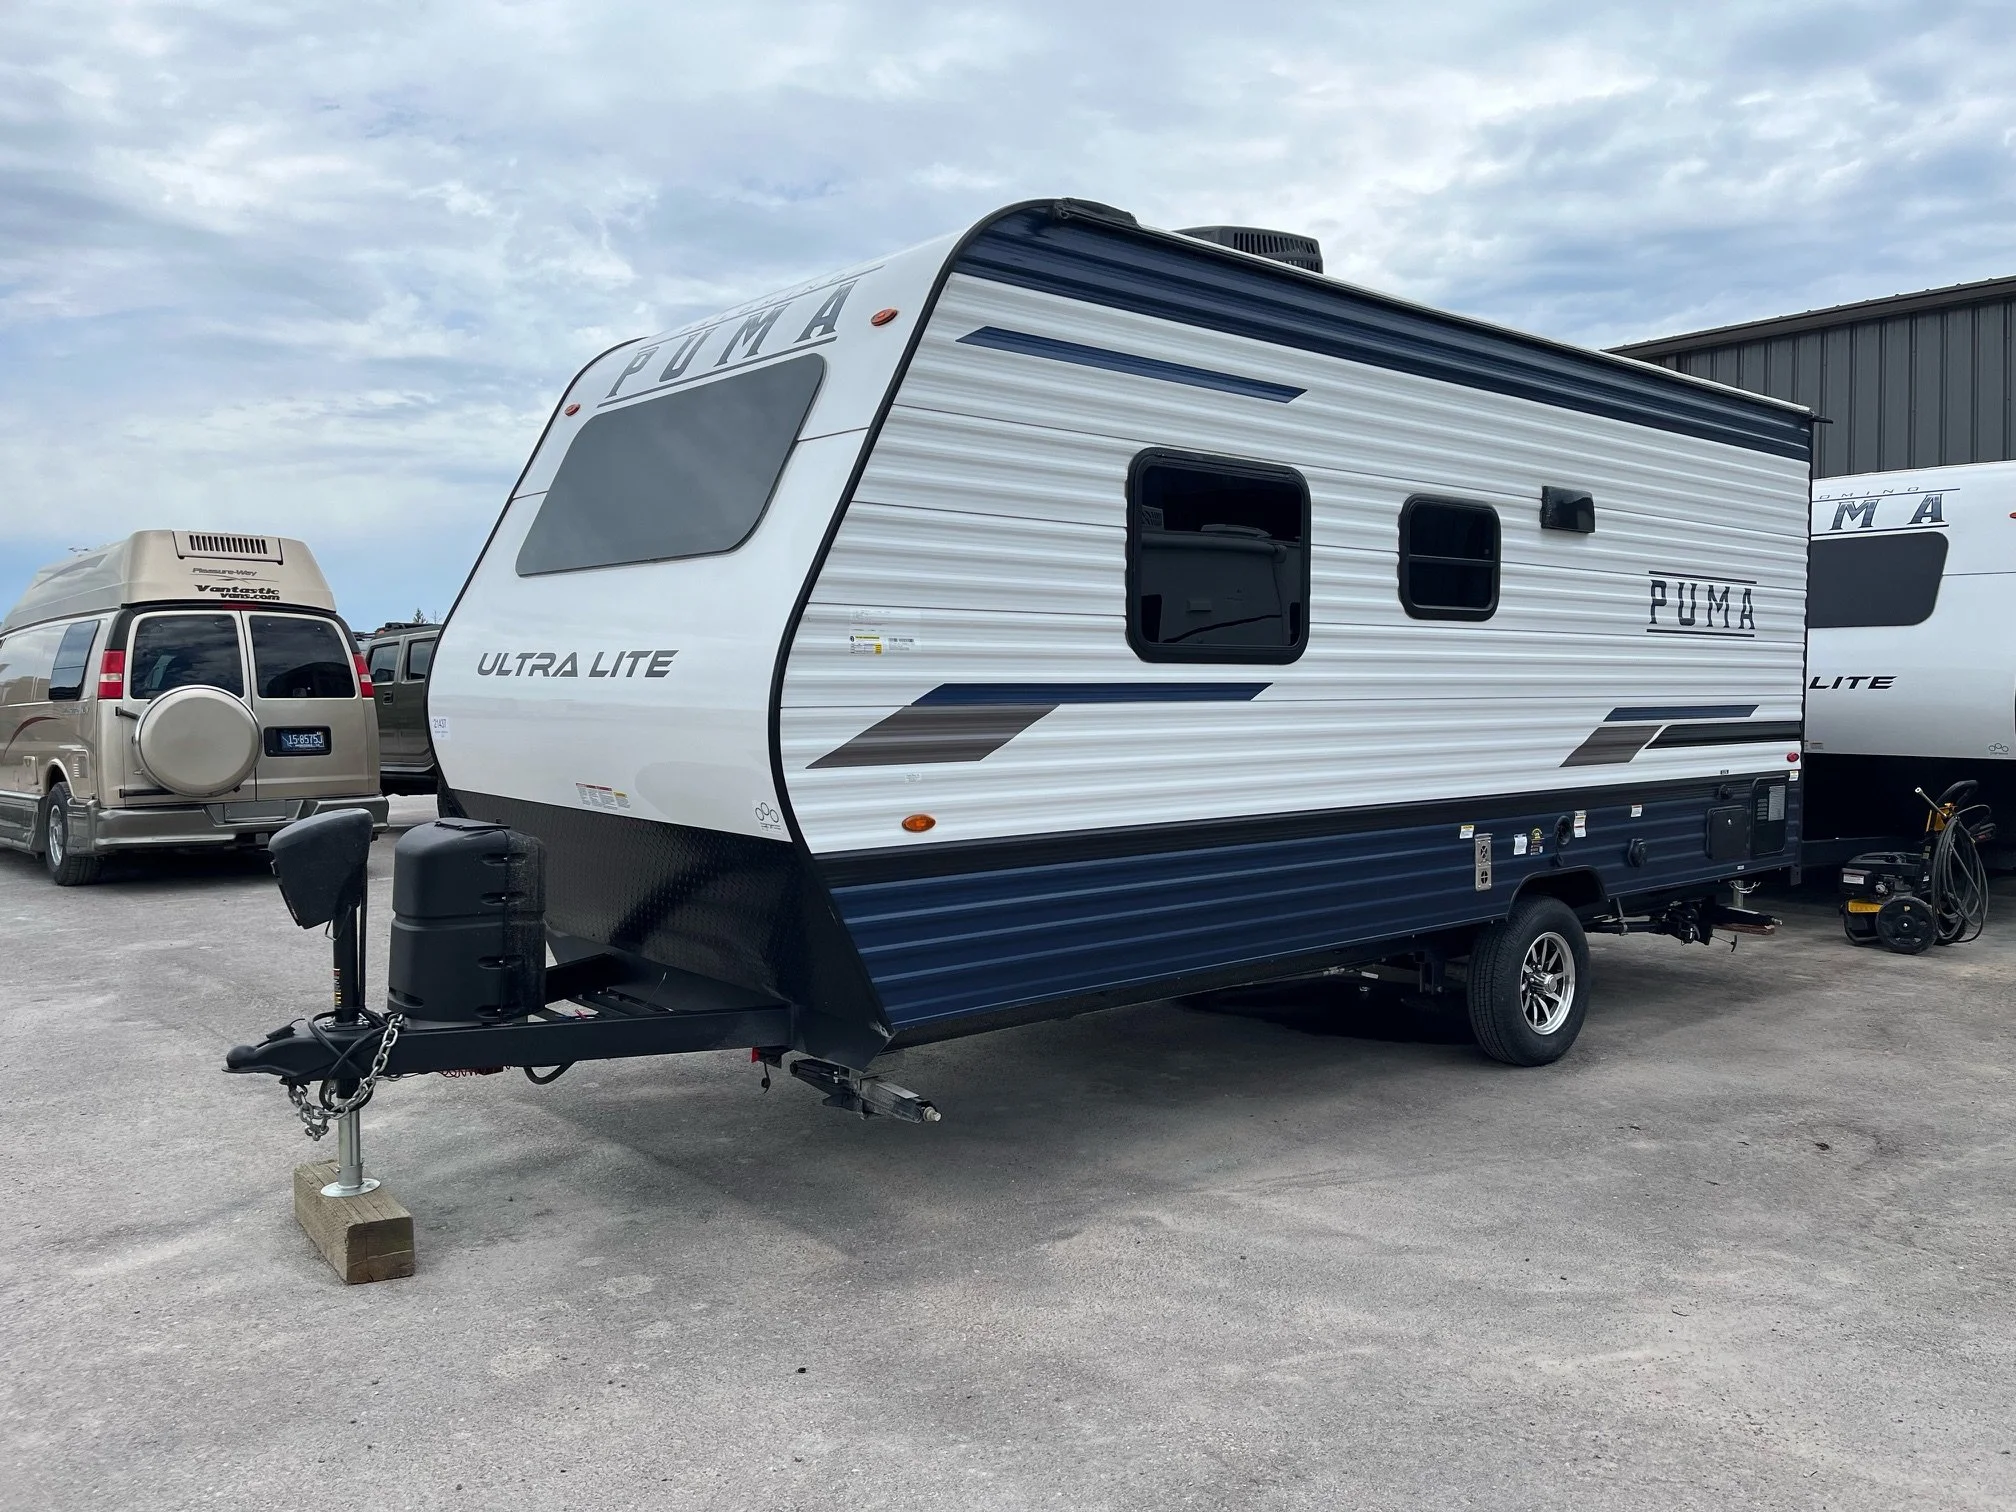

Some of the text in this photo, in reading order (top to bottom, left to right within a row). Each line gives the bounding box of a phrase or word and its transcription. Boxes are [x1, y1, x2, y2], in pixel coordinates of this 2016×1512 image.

[604, 279, 861, 399] PUMA
[192, 567, 258, 577] Pleasure-Way
[194, 584, 280, 595] Vantastic
[220, 593, 281, 601] vans.com
[1648, 579, 1756, 630] PUMA
[477, 650, 680, 678] ULTRA LITE
[1808, 676, 1898, 690] LITE
